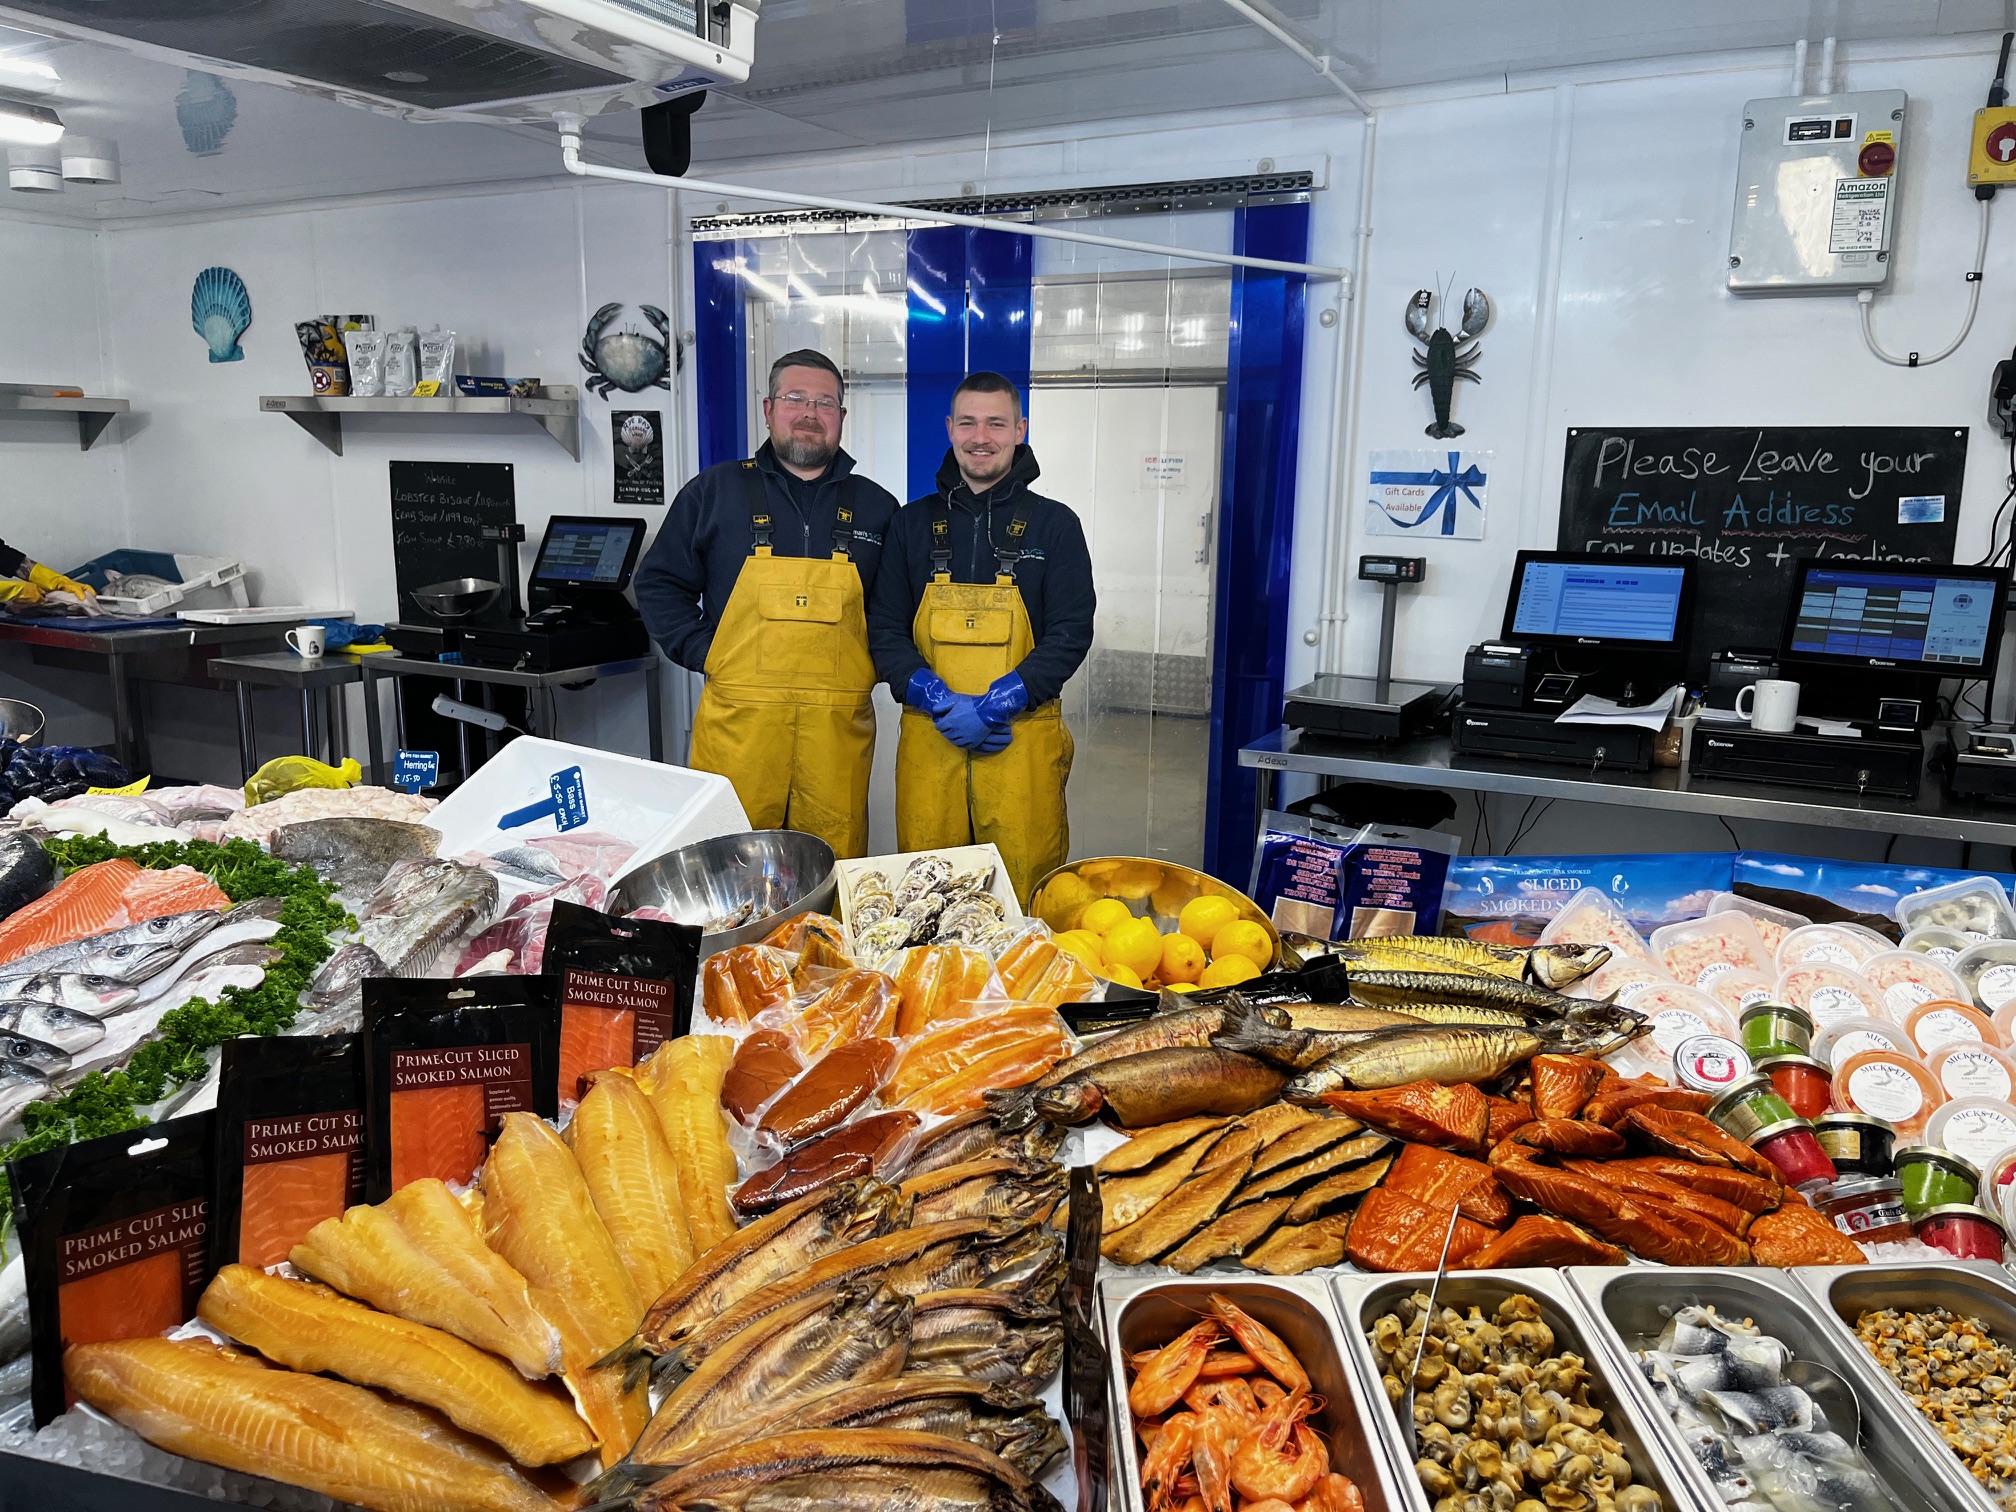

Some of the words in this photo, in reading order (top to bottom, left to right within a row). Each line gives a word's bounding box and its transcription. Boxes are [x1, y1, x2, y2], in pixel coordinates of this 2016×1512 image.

[1837, 182, 1886, 192] Amazon
[1594, 437, 1731, 487] Please
[1737, 431, 1839, 482] Leave
[1848, 450, 1935, 499] your
[1385, 487, 1400, 496] Gift
[1401, 488, 1425, 497] Cards
[1385, 503, 1422, 512] Available
[1721, 491, 1856, 529] Address
[403, 760, 428, 771] Herring
[1257, 755, 1288, 766] Adexa
[566, 785, 577, 810] Bass
[1566, 868, 1591, 876] SMOKED
[1283, 887, 1308, 899] TROUT
[1523, 878, 1582, 892] SLICED
[1361, 897, 1384, 906] TROUT
[1480, 898, 1552, 913] SMOKED
[569, 972, 604, 987] PRIME
[606, 977, 630, 991] CUT
[633, 980, 667, 996] SLICED
[567, 987, 614, 1004] SMOKED
[617, 993, 659, 1009] SALMON
[396, 1054, 440, 1068] PRIME
[444, 1051, 474, 1064] CUT
[478, 1049, 520, 1062] SLICED
[396, 1070, 456, 1086] SMOKED
[460, 1066, 511, 1080] SALMON
[251, 1121, 302, 1139] PRIME
[307, 1117, 339, 1132] CUT
[343, 1114, 364, 1128] SLI
[250, 1138, 317, 1158] SMOKED
[322, 1133, 367, 1149] SALMO
[65, 1227, 122, 1255] PRIME
[128, 1213, 166, 1236] CUT
[171, 1201, 209, 1223] SLIC
[66, 1242, 142, 1276] SMOKED
[148, 1222, 206, 1251] SALMO
